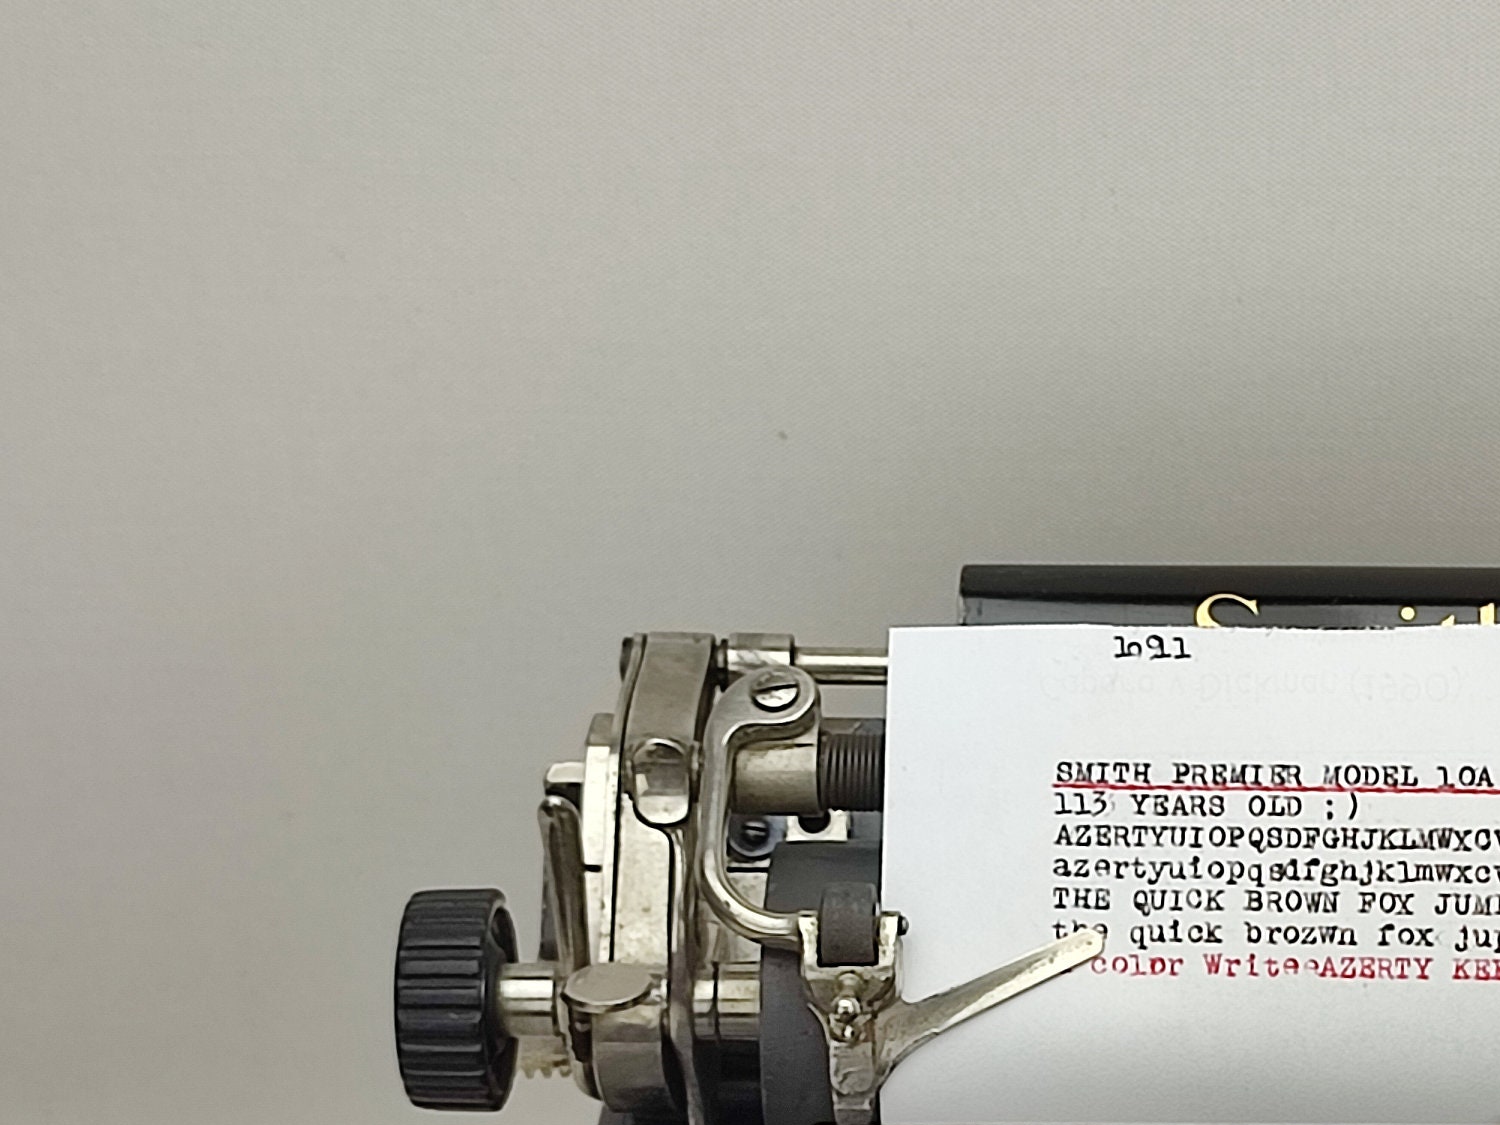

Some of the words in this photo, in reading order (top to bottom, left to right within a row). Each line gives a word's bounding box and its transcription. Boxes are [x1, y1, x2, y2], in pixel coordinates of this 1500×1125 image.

[1057, 761, 1151, 782] SMITH
[1172, 763, 1302, 783] PREMIER
[1323, 764, 1418, 785] MODEL
[1130, 794, 1225, 817] YEARS
[1248, 791, 1305, 817] OLD
[1053, 887, 1110, 910] THE
[1133, 888, 1225, 917] QUICK
[1244, 890, 1340, 913] BROWN
[1358, 892, 1415, 915] FOX
[1130, 919, 1223, 950] quick
[1377, 923, 1434, 947] fox
